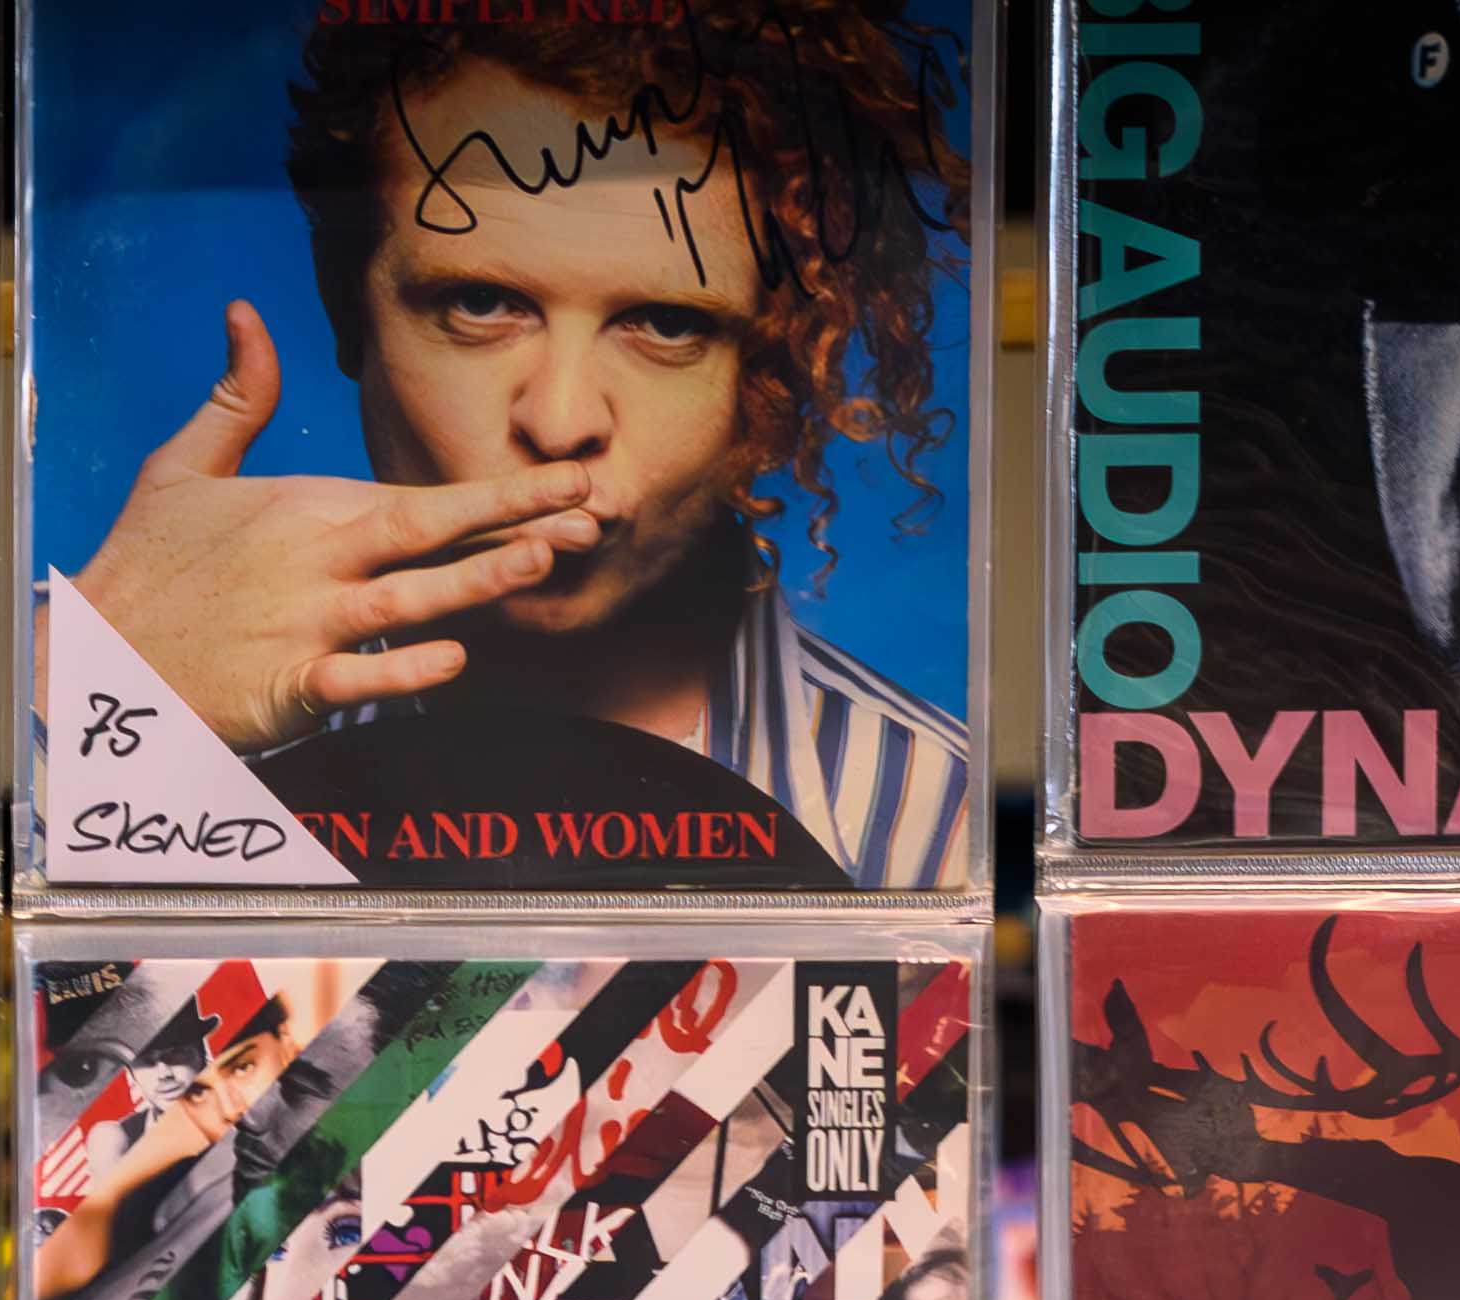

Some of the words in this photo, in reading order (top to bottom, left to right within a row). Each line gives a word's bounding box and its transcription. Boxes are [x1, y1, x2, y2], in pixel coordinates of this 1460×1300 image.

[1078, 198, 1203, 711] AUDIO
[79, 692, 158, 757] 75
[308, 812, 370, 859] EN
[389, 811, 520, 860] AND
[540, 811, 779, 860] WOMEN
[806, 1089, 887, 1129] SINGLES
[806, 1128, 884, 1193] ONLY
